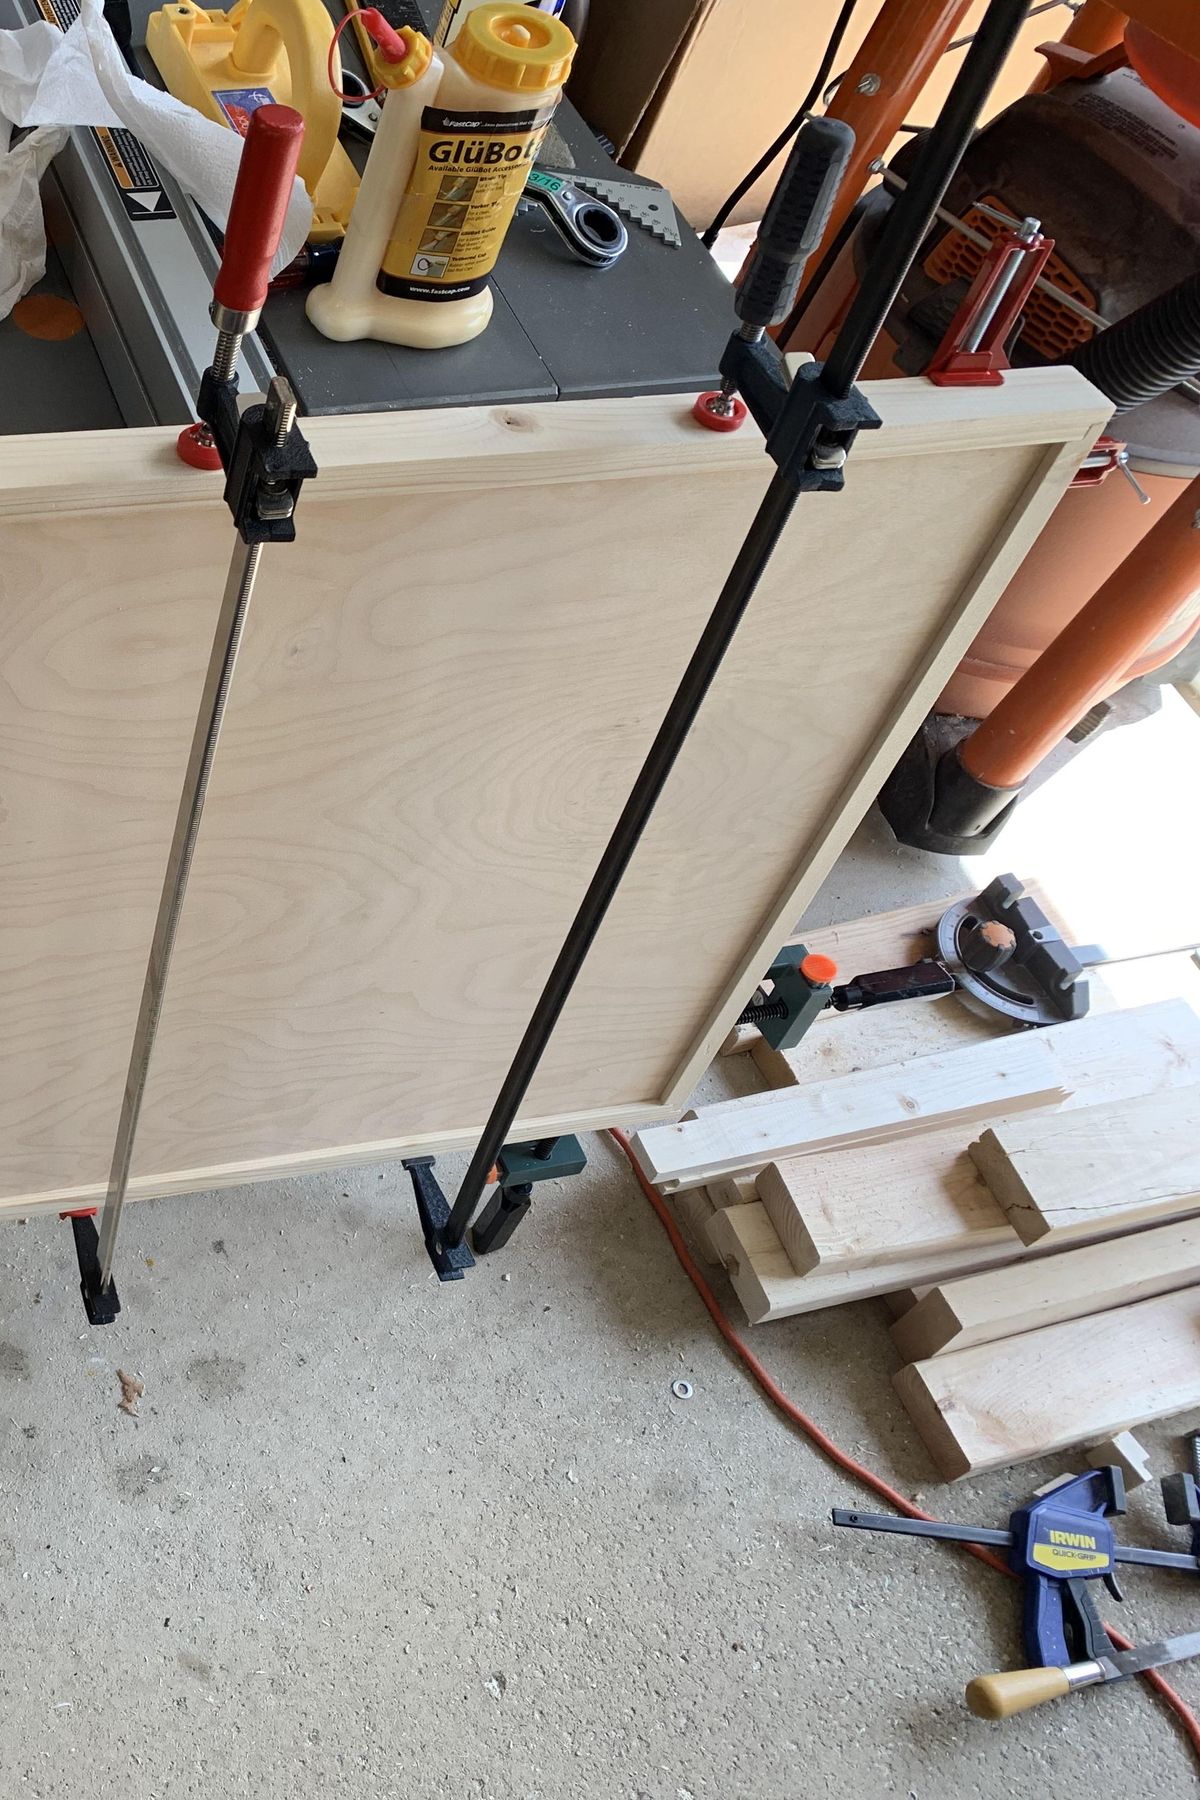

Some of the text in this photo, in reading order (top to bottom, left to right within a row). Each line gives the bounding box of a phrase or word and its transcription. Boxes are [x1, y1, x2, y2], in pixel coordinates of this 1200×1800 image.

[428, 138, 535, 165] GlüBot
[428, 164, 464, 173] Available
[409, 286, 471, 295] www.fastcap.com
[1049, 1529, 1097, 1550] IRWIN
[1052, 1548, 1097, 1561] QUICK-GRIP
